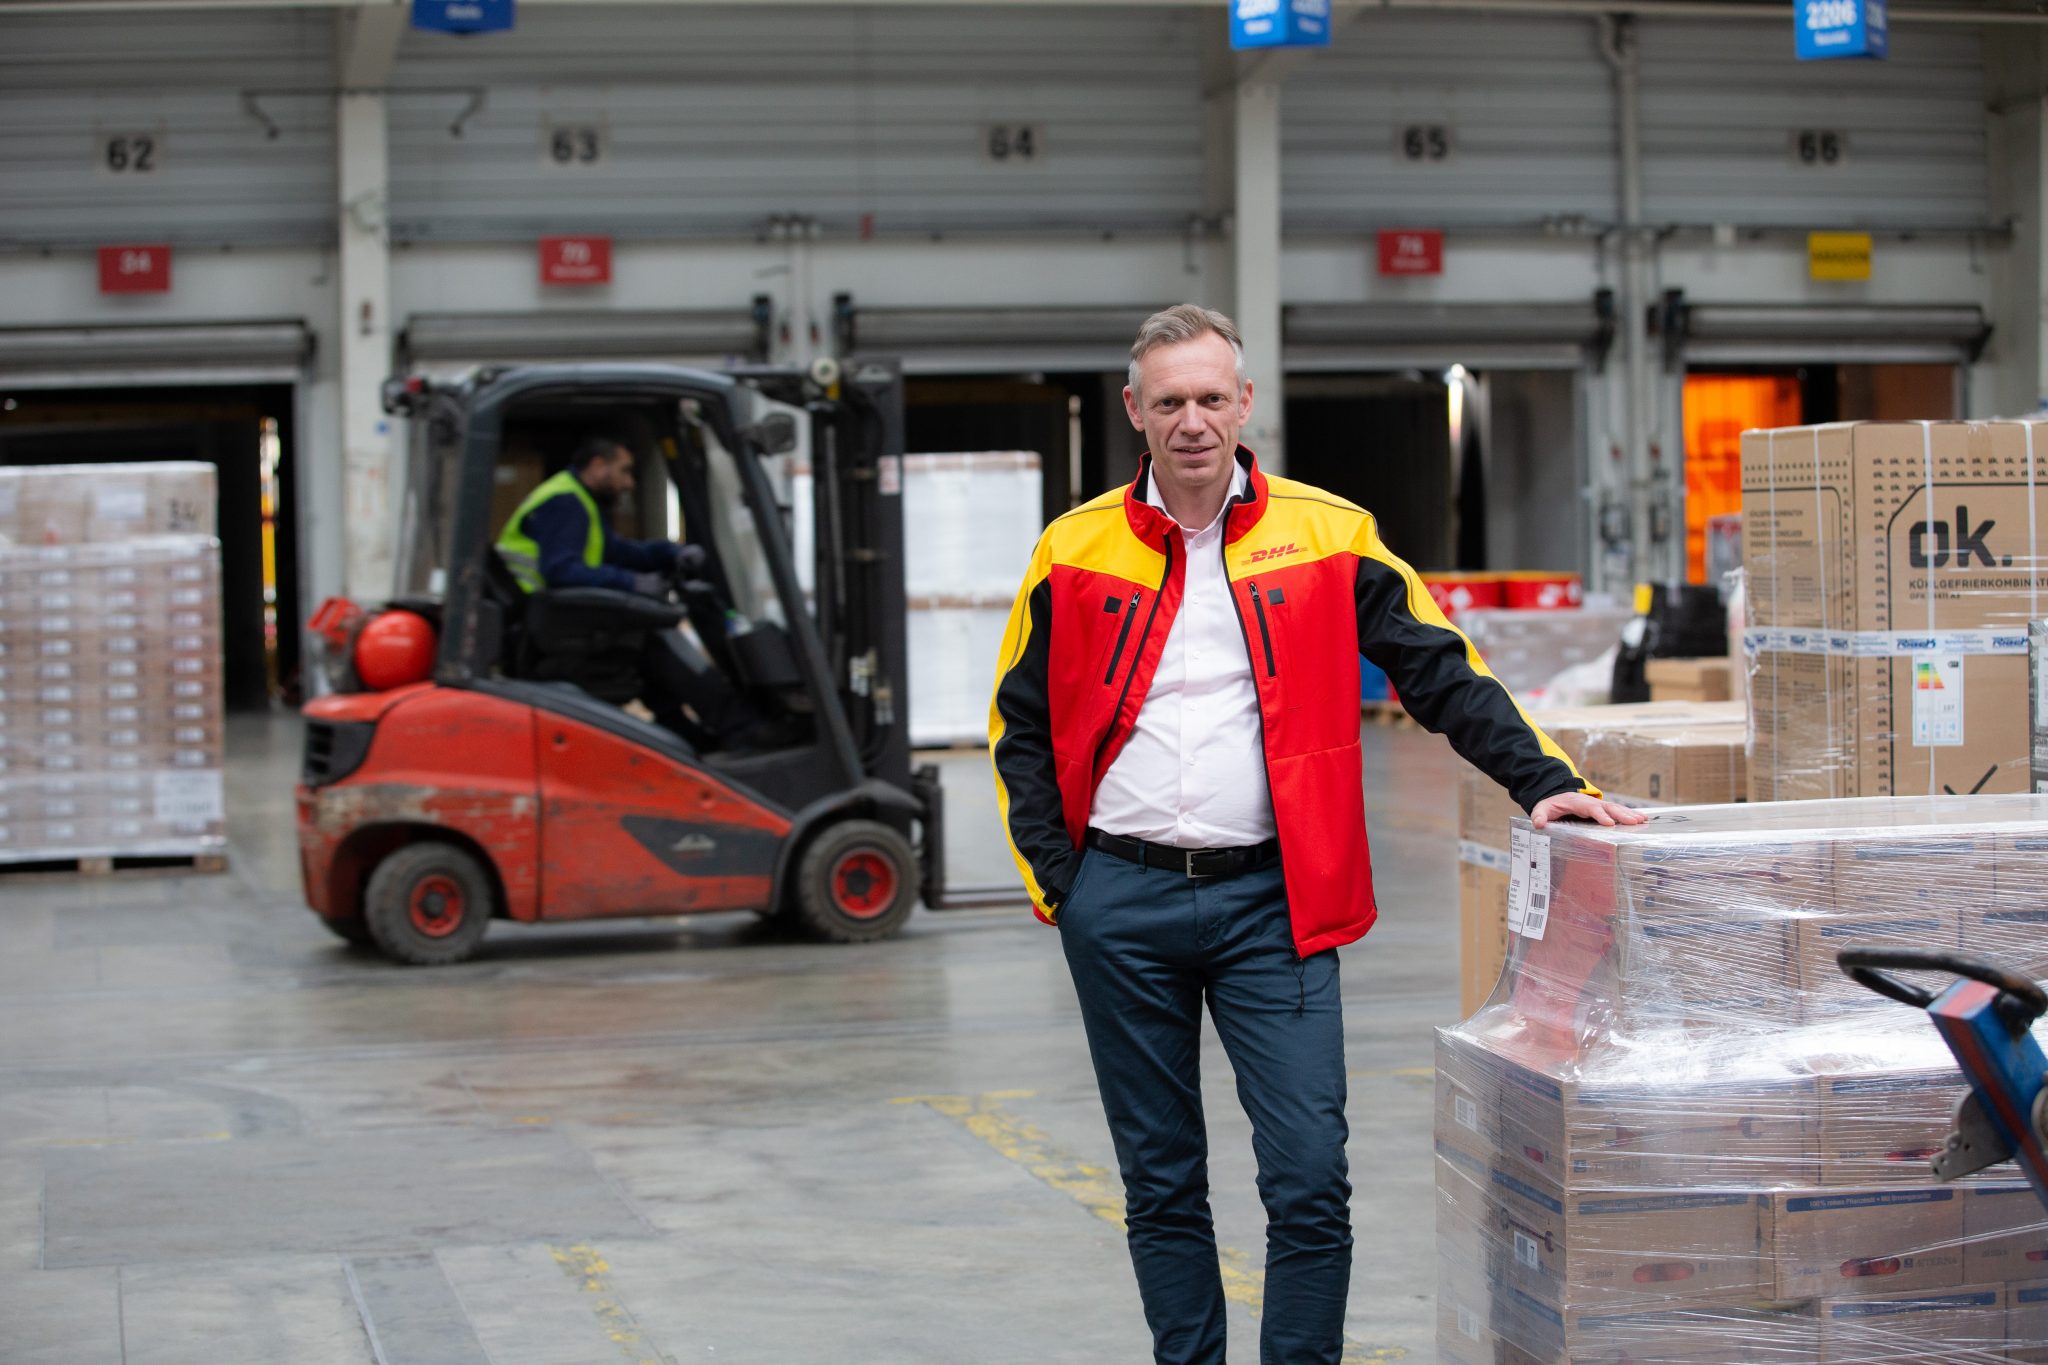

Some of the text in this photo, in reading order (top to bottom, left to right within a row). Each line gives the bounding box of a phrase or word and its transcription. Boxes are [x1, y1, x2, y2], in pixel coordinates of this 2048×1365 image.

[107, 136, 154, 171] 62
[552, 126, 599, 164] 63
[989, 125, 1035, 161] 64
[1404, 124, 1448, 161] 65
[1799, 130, 1839, 166] 66
[1250, 543, 1300, 563] DHL
[1909, 505, 2012, 568] ok.
